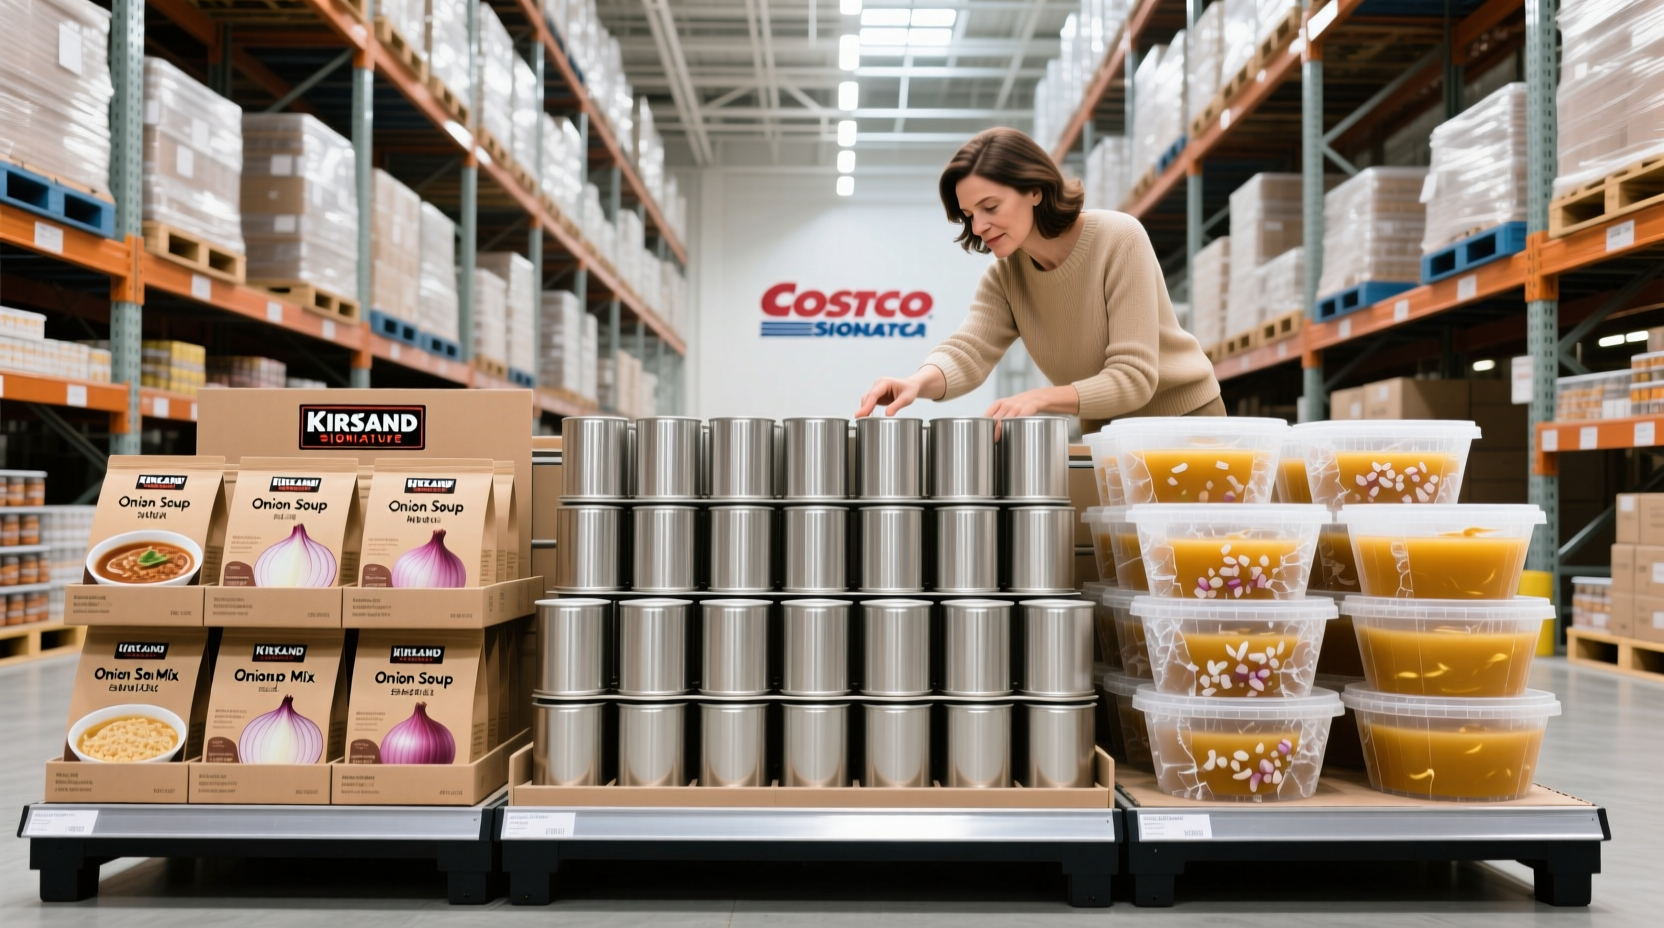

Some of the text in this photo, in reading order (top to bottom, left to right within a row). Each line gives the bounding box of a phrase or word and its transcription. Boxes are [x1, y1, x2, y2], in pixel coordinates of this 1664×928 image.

[761, 283, 933, 317] COSTCO
[307, 411, 418, 432] KIRSAND
[252, 497, 327, 514] Onion Soup
[389, 499, 464, 516] Onion Soup
[375, 671, 453, 689] Onion Soup
